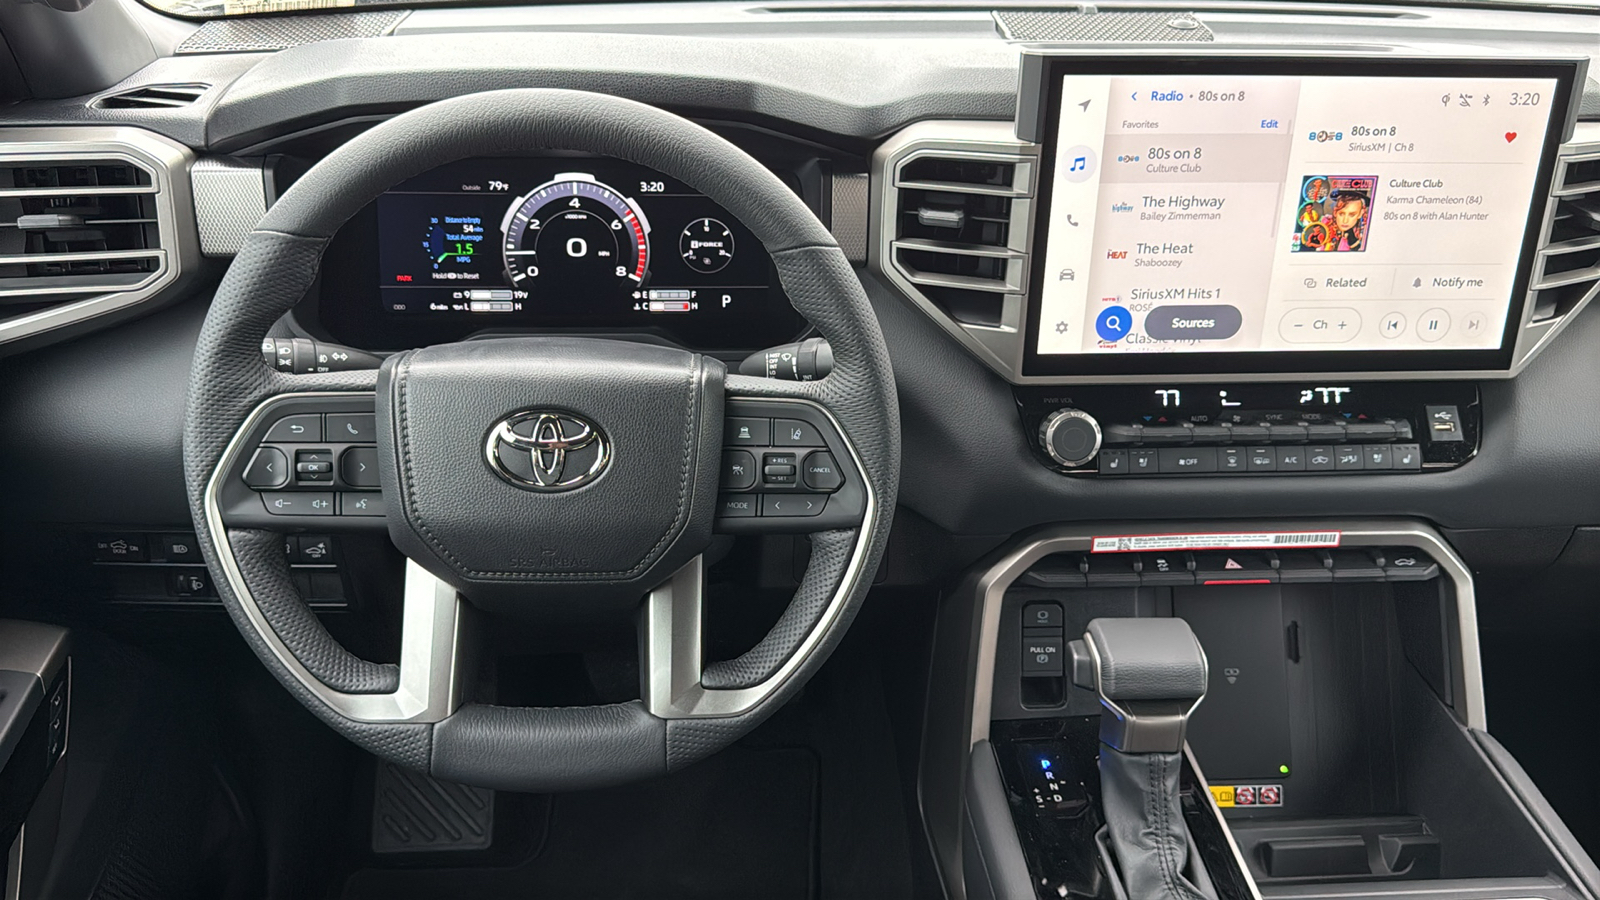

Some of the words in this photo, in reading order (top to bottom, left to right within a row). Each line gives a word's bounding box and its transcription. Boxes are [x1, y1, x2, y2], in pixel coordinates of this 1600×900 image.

[1151, 91, 1183, 101] Radio
[1199, 91, 1218, 101] 80s
[1220, 93, 1235, 101] on
[1238, 91, 1245, 101] 8
[1509, 93, 1540, 105] 3:20
[1261, 120, 1278, 128] Edit
[1352, 127, 1370, 136] 80s
[1389, 127, 1396, 136] 8
[1349, 143, 1385, 152] SiriusXM
[1395, 143, 1407, 152] Ch
[1408, 143, 1414, 152] 8
[1148, 148, 1170, 159] 80s
[1173, 150, 1190, 159] on
[1194, 148, 1202, 159] 8
[1146, 164, 1178, 173] Culture
[1180, 164, 1201, 172] Club
[640, 182, 664, 192] 3:20
[1389, 180, 1421, 188] Culture
[1423, 180, 1443, 188] Club
[568, 198, 581, 208] 4
[1143, 196, 1165, 207] The
[1169, 196, 1225, 210] Highway
[1387, 196, 1414, 204] Karma
[1416, 196, 1463, 204] Chameleon
[1466, 196, 1483, 205] (84)
[1140, 212, 1166, 222] Bailey
[1168, 212, 1221, 220] Zimmerman
[1384, 212, 1398, 220] 80s
[1413, 212, 1418, 220] 8
[1419, 212, 1437, 220] with
[1438, 212, 1457, 220] Alan
[1459, 212, 1488, 220] Hunter
[463, 224, 473, 232] 54
[530, 219, 540, 229] 2
[611, 219, 622, 230] 6
[461, 234, 483, 242] Average
[455, 243, 473, 254] 1.5
[566, 238, 587, 257] 0
[1137, 243, 1159, 254] The
[1163, 243, 1193, 253] Heat
[1107, 251, 1128, 259] HEAT
[1135, 259, 1182, 268] Shaboozey
[527, 266, 538, 276] 0
[616, 266, 626, 276] 8
[1326, 278, 1367, 287] Related
[1433, 278, 1465, 288] Notify
[464, 290, 470, 298] 9
[514, 291, 528, 299] 19V
[1131, 289, 1185, 299] SiriusXM
[1188, 288, 1212, 299] Hits
[1215, 288, 1220, 298] 1
[430, 302, 436, 310] 6
[464, 302, 469, 310] L
[642, 302, 648, 310] C
[692, 302, 698, 310] H
[722, 294, 731, 308] P
[1172, 318, 1215, 328] Sources
[1313, 320, 1328, 329] Ch
[1126, 333, 1168, 344] Clas
[510, 558, 535, 568] SRS
[540, 558, 589, 568] AIRBAG
[1041, 760, 1051, 769] P
[1036, 795, 1043, 803] S
[1053, 794, 1062, 802] D
